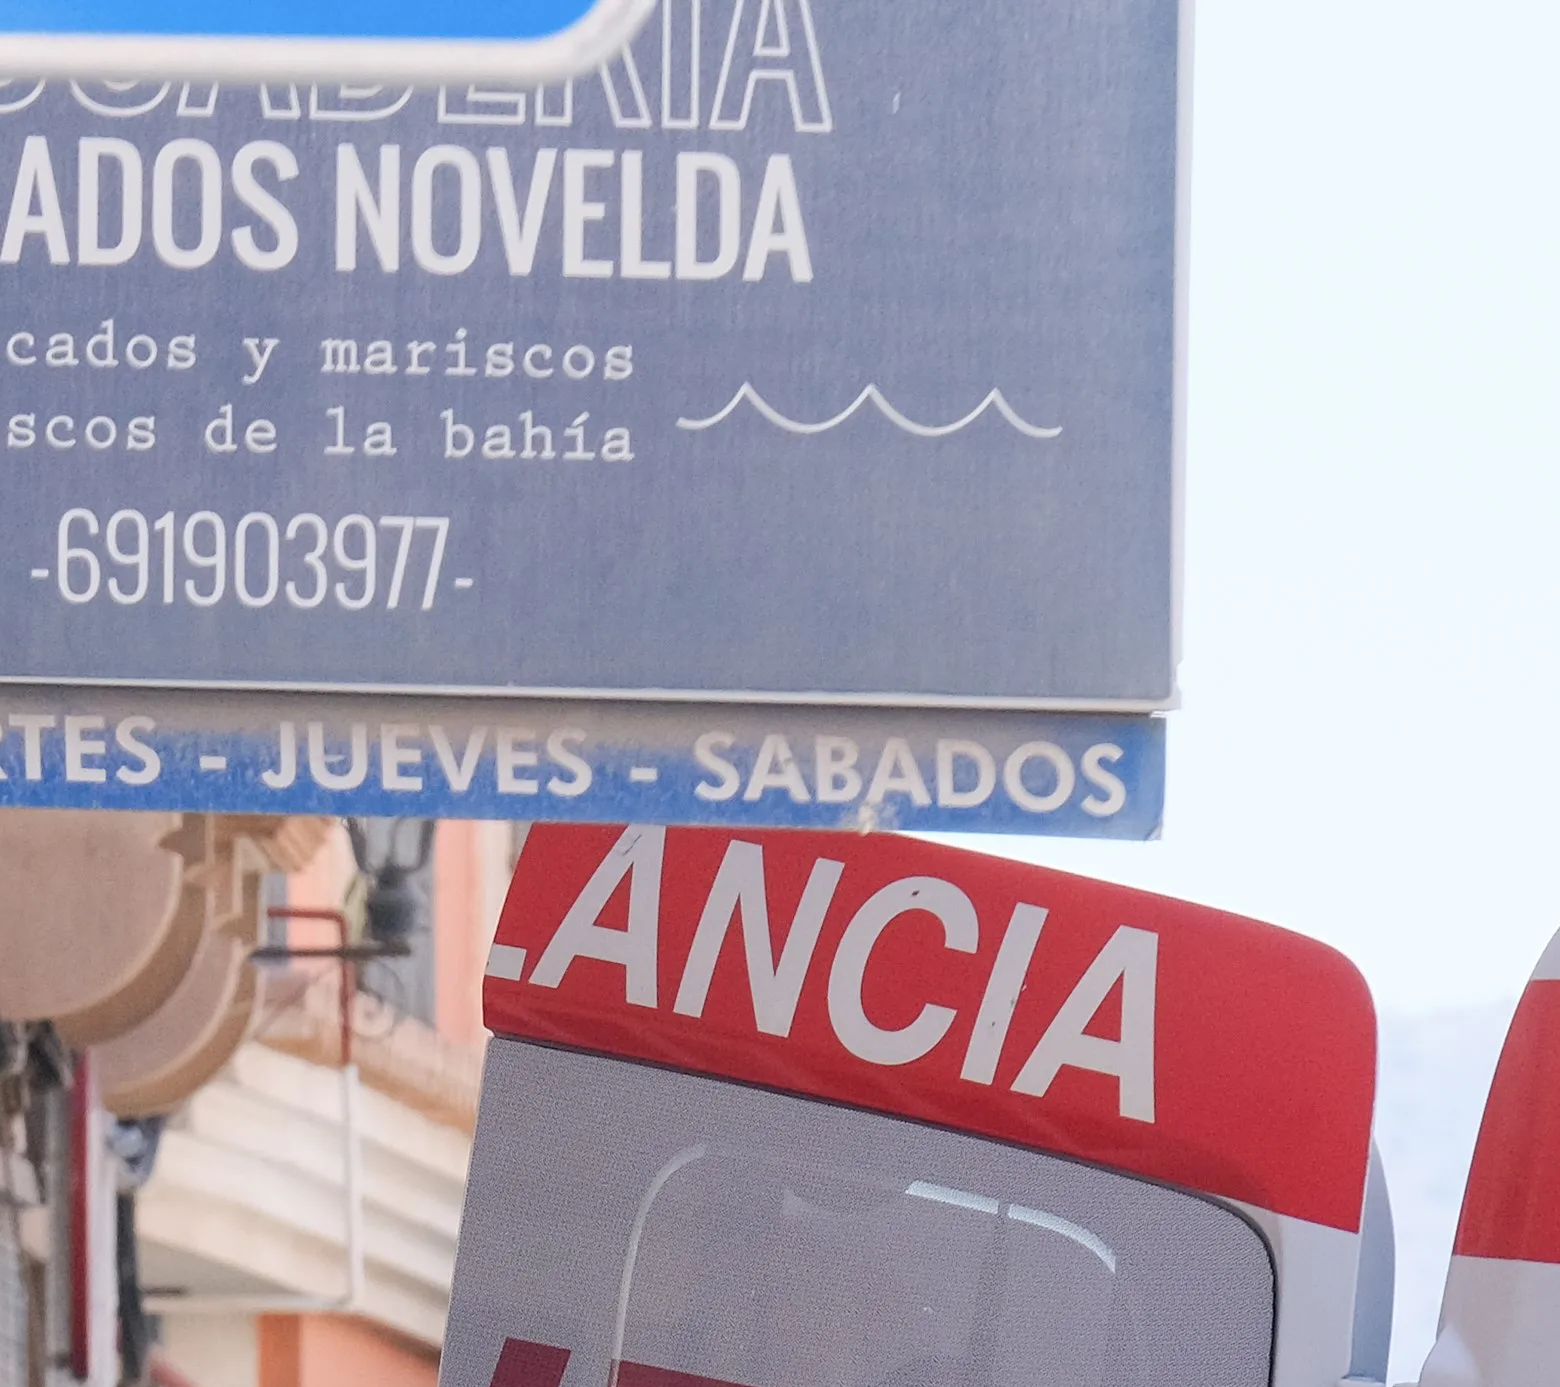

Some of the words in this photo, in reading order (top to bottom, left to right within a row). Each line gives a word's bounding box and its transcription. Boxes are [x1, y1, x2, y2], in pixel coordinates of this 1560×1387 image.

[334, 142, 813, 283] NOVELDA
[242, 335, 279, 385] y
[321, 327, 634, 381] mariscos
[204, 403, 278, 454] de
[323, 407, 398, 458] la
[442, 409, 635, 462] bahía
[30, 508, 474, 610] -691903977-
[260, 720, 593, 798] JUEVES
[693, 730, 1127, 818] SABADOS
[484, 824, 1159, 1124] ANCIA
